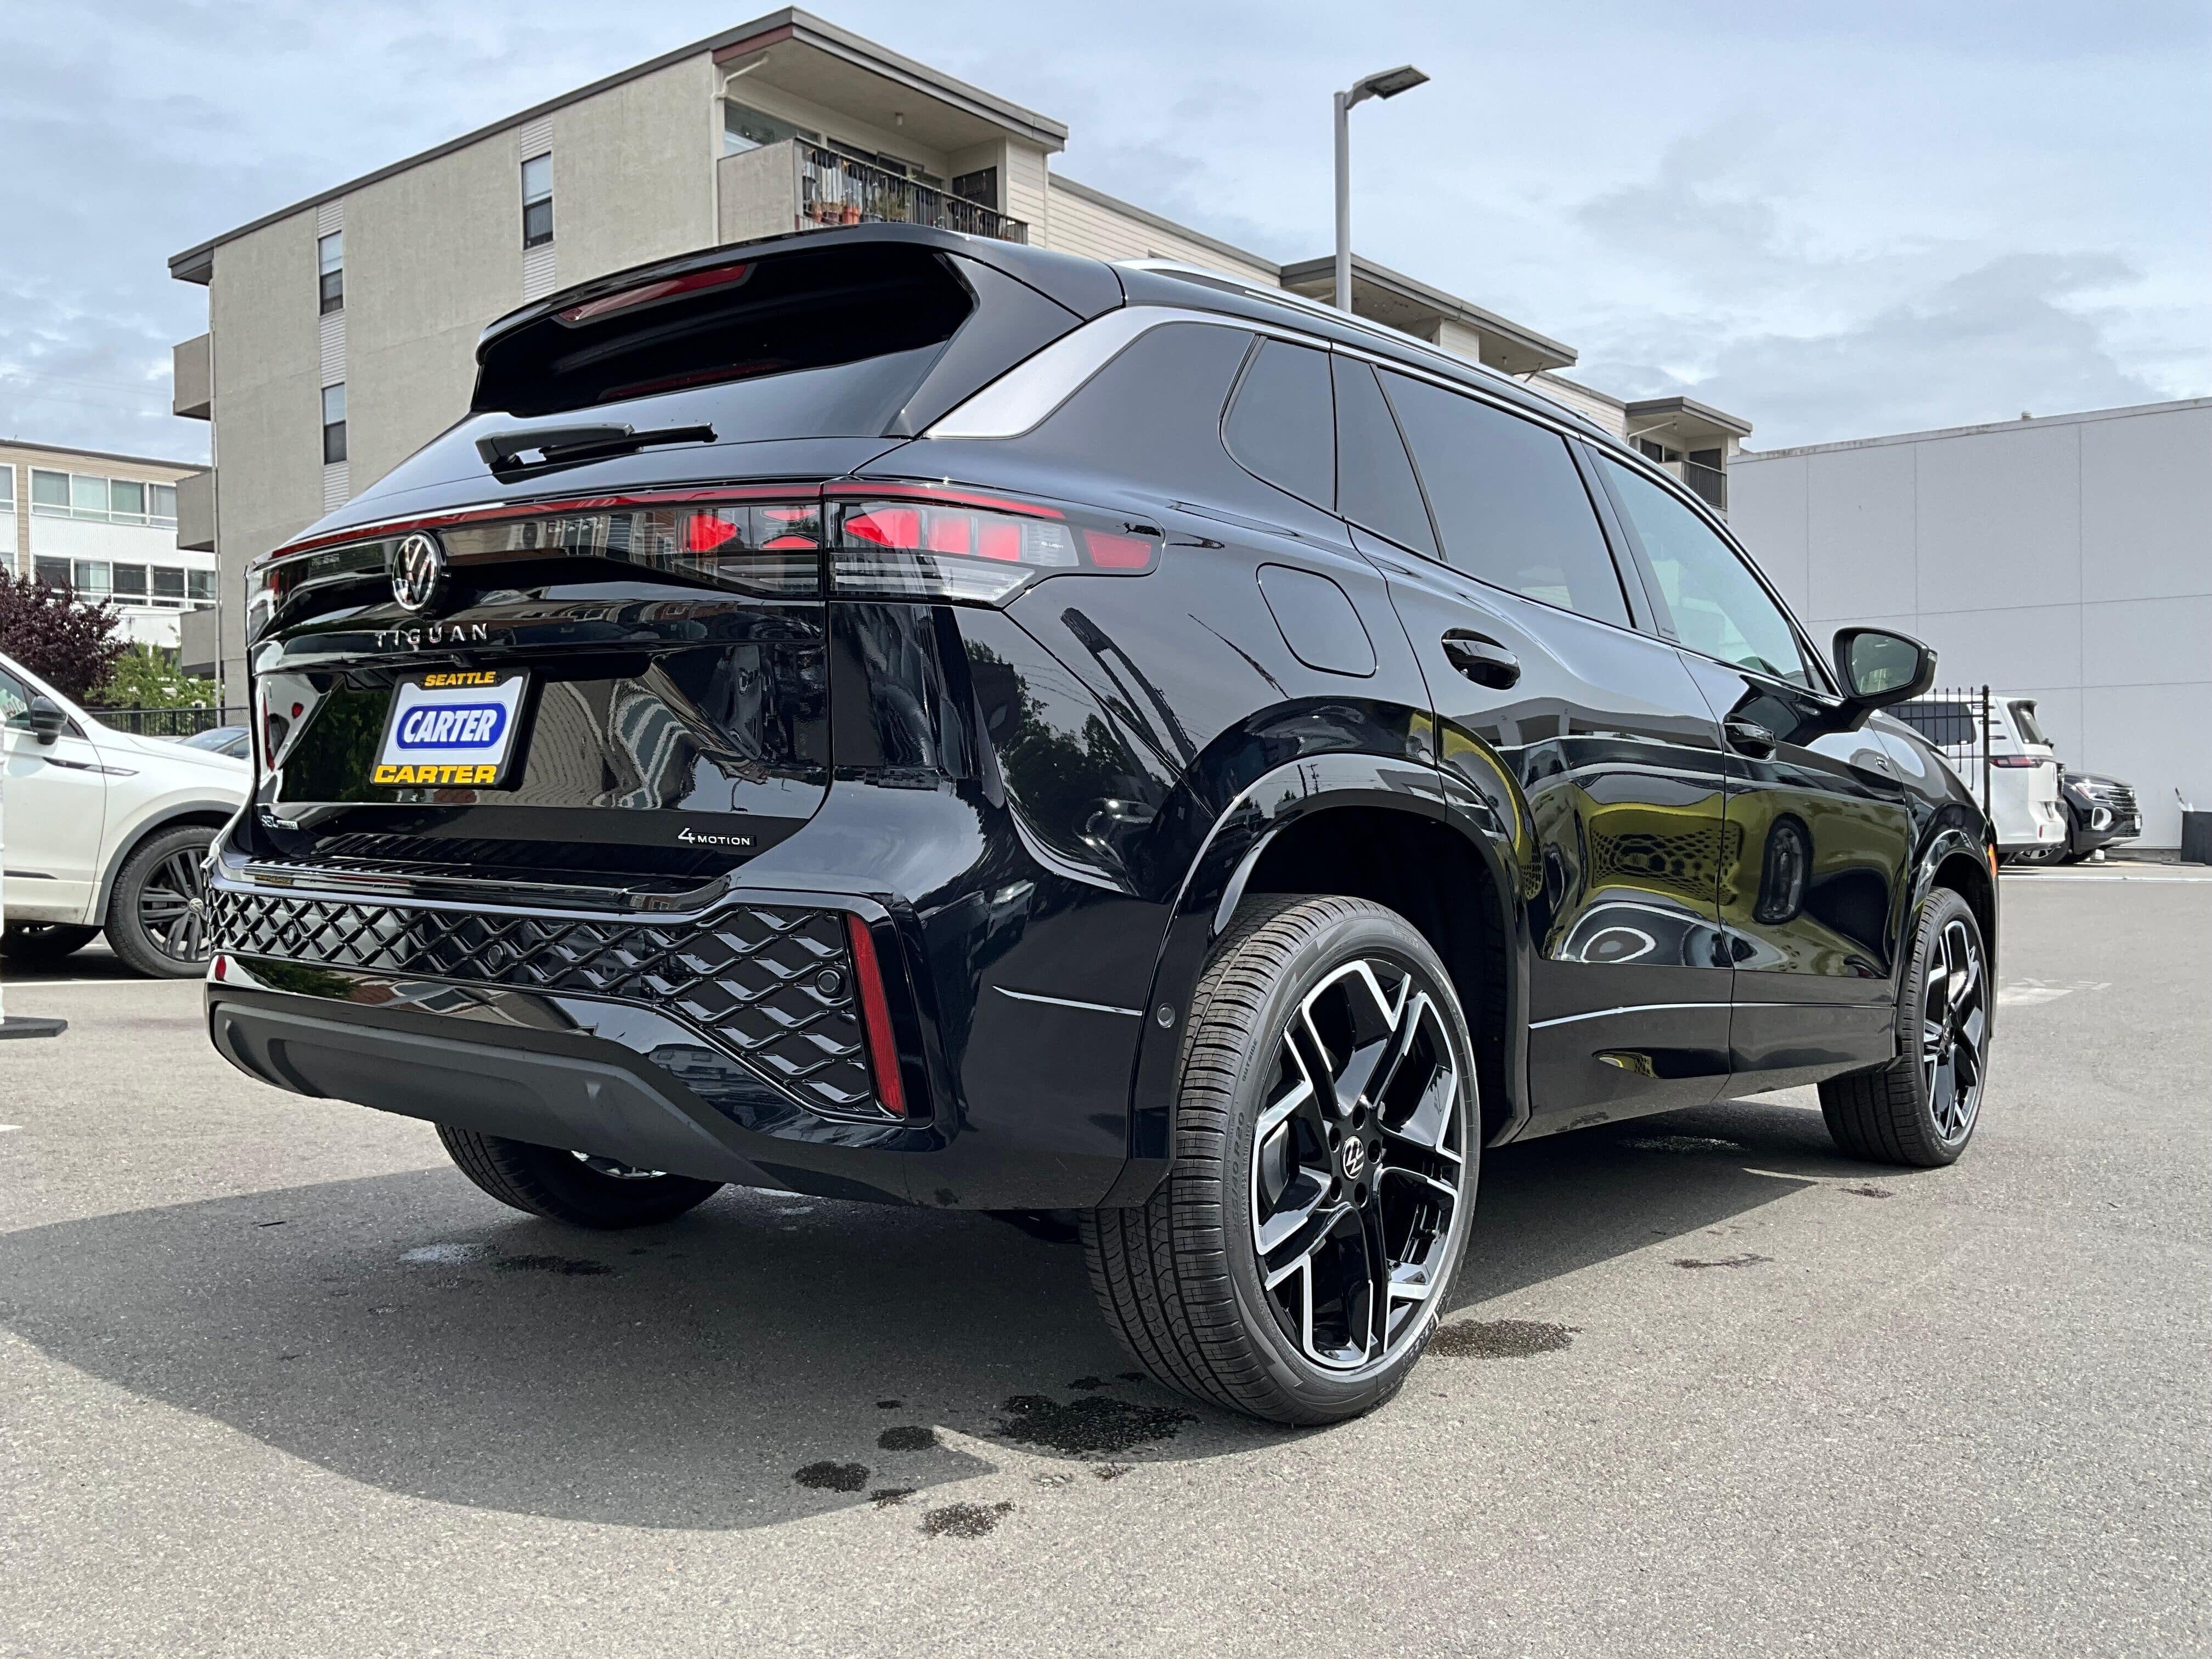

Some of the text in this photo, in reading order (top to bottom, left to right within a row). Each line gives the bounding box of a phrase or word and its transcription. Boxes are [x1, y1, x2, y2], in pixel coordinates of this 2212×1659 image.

[375, 623, 488, 648] TIGUAN
[424, 671, 496, 686] SEATTLE
[403, 709, 498, 743] CARTER
[374, 765, 497, 784] CARTER
[678, 827, 751, 845] 4MOTION
[1242, 1038, 1258, 1082] OUTSIDE
[1231, 1160, 1240, 1235] 255/40
